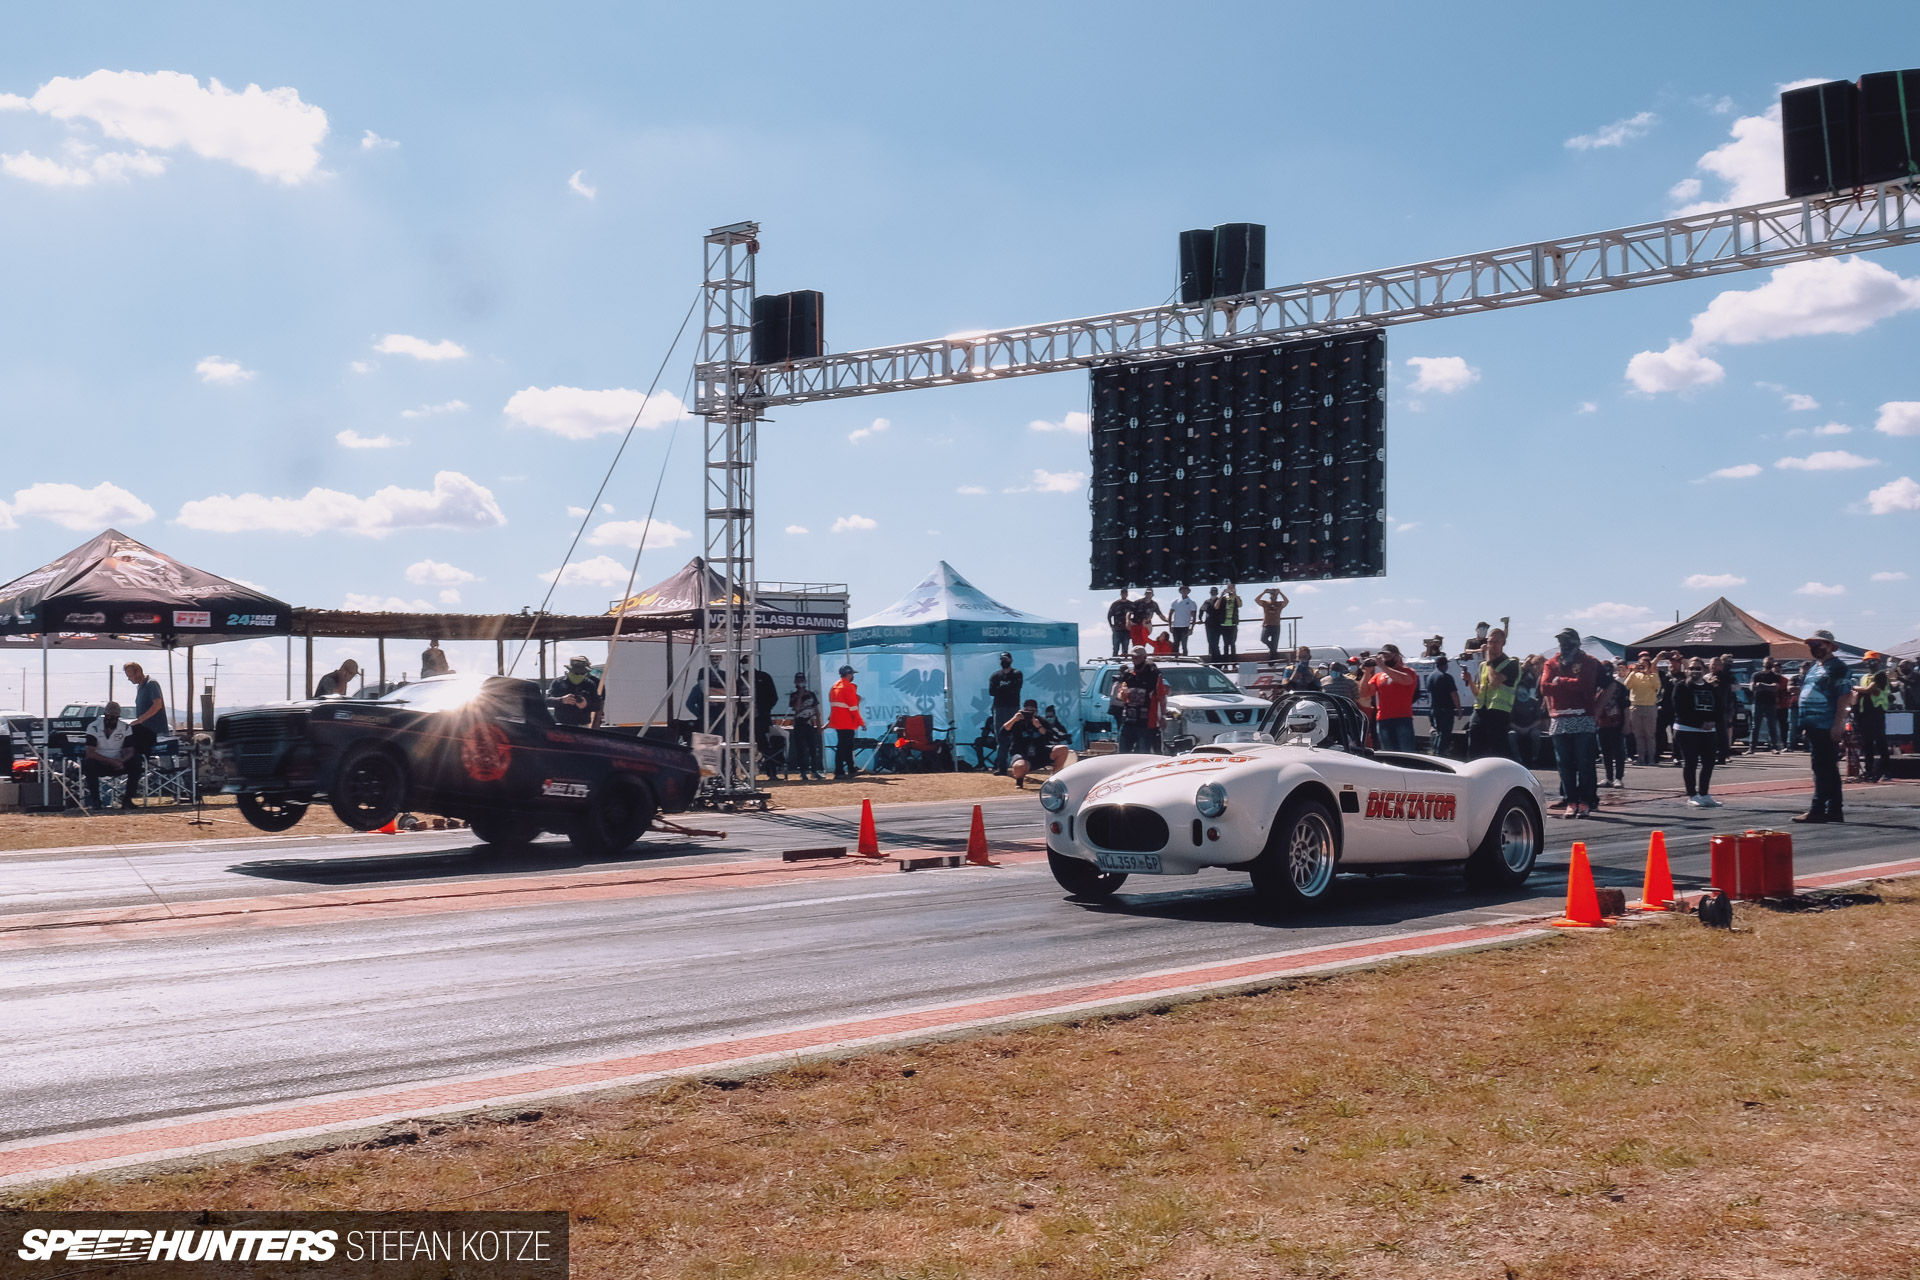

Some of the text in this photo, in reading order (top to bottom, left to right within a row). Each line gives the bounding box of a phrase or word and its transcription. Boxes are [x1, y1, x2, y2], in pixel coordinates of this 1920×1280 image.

[753, 613, 794, 625] CLASS
[796, 615, 846, 628] GAMING
[884, 627, 912, 638] CLINIC
[981, 626, 1047, 639] MEDICAL CLINIC
[1364, 789, 1456, 821] DICKTATOR
[1145, 855, 1158, 870] GP
